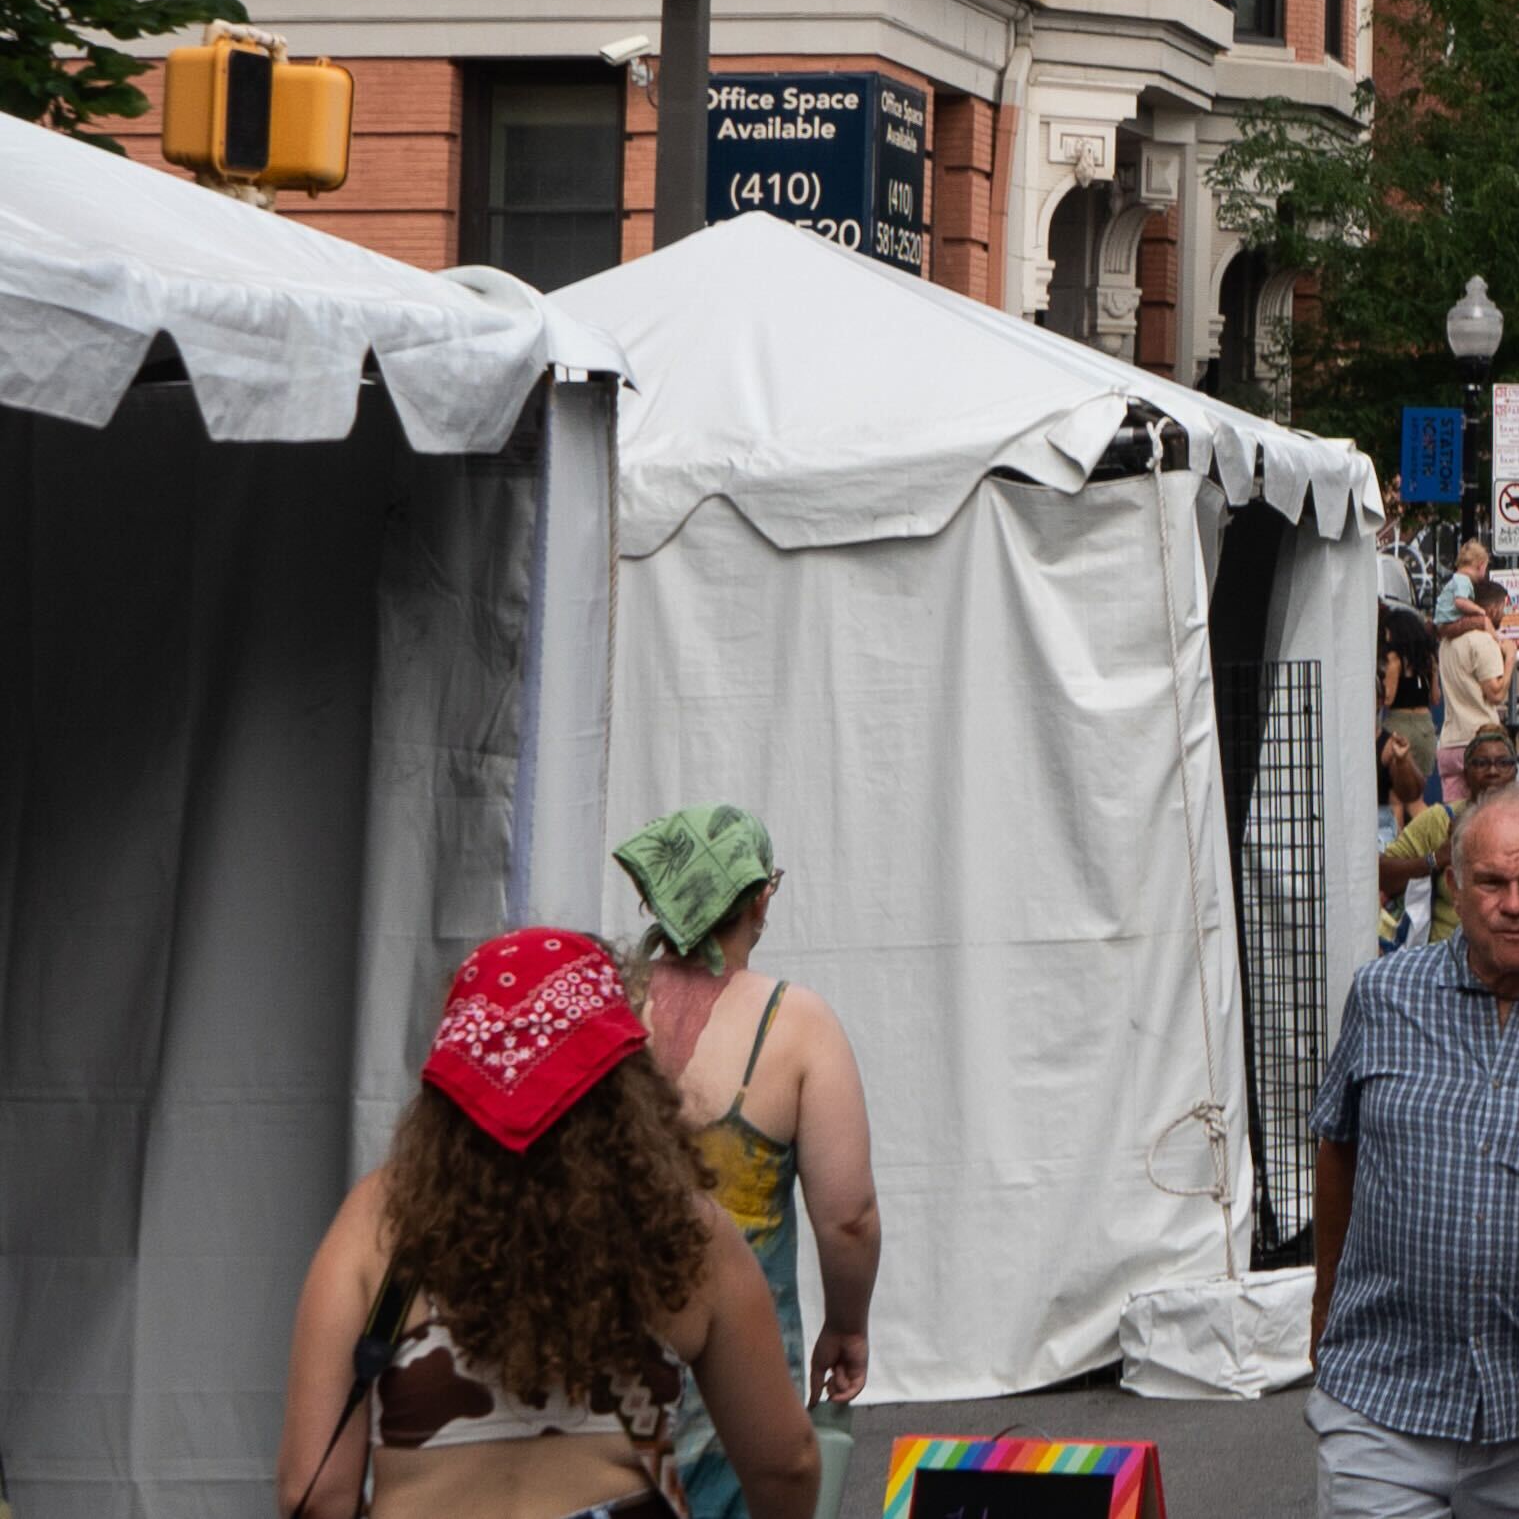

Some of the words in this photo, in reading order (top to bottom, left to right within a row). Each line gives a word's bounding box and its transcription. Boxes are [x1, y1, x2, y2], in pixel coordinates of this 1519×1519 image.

[783, 88, 859, 113] Space
[881, 91, 904, 117] Office
[904, 99, 924, 127] Space
[717, 117, 836, 140] Available
[886, 126, 917, 153] Available
[730, 172, 822, 210] (410)
[888, 179, 913, 222] (410)
[876, 221, 922, 265] 581-2520
